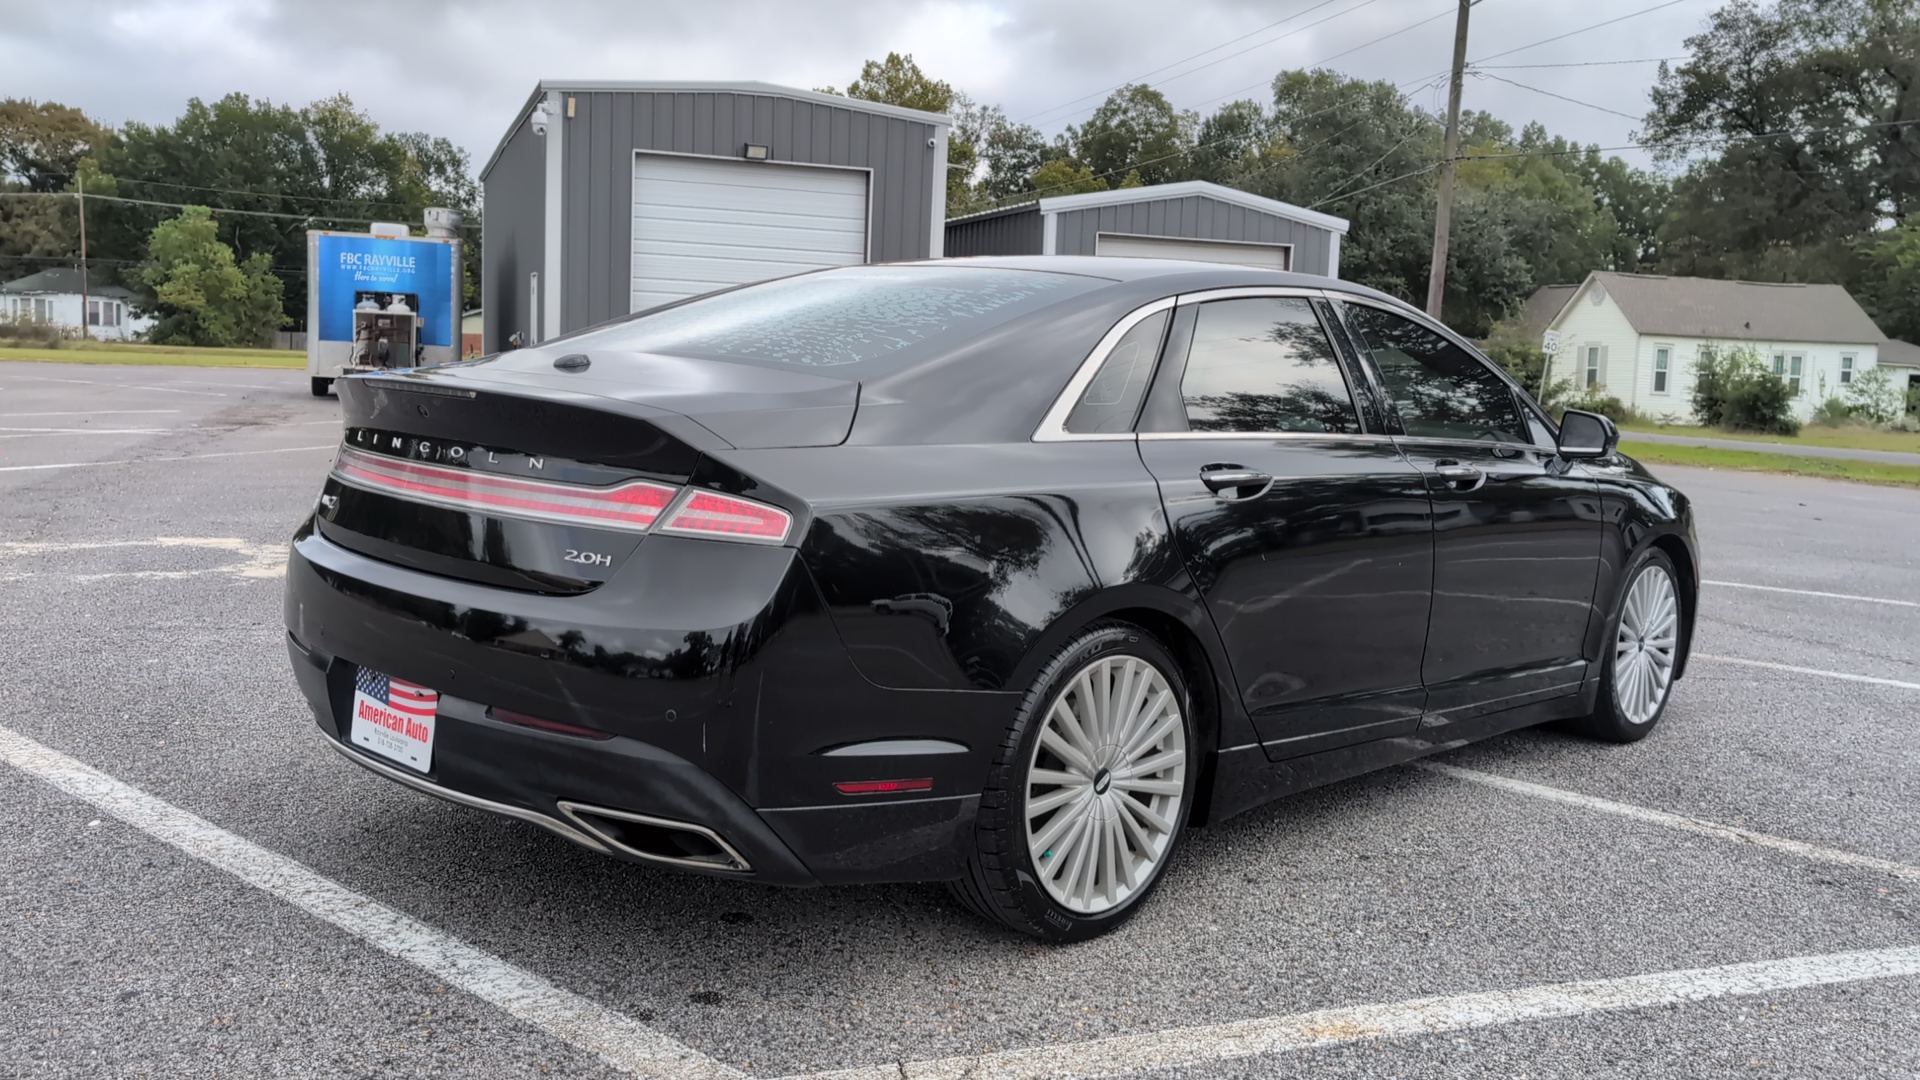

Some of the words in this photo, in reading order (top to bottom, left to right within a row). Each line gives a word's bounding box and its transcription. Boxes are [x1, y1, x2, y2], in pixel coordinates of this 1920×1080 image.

[340, 252, 362, 265] FBC
[364, 254, 416, 268] RAYVILLE
[1544, 342, 1558, 352] 40
[356, 430, 545, 471] LINCOLN
[564, 548, 612, 567] 2.0H
[358, 699, 405, 735] American
[405, 717, 429, 743] Auto
